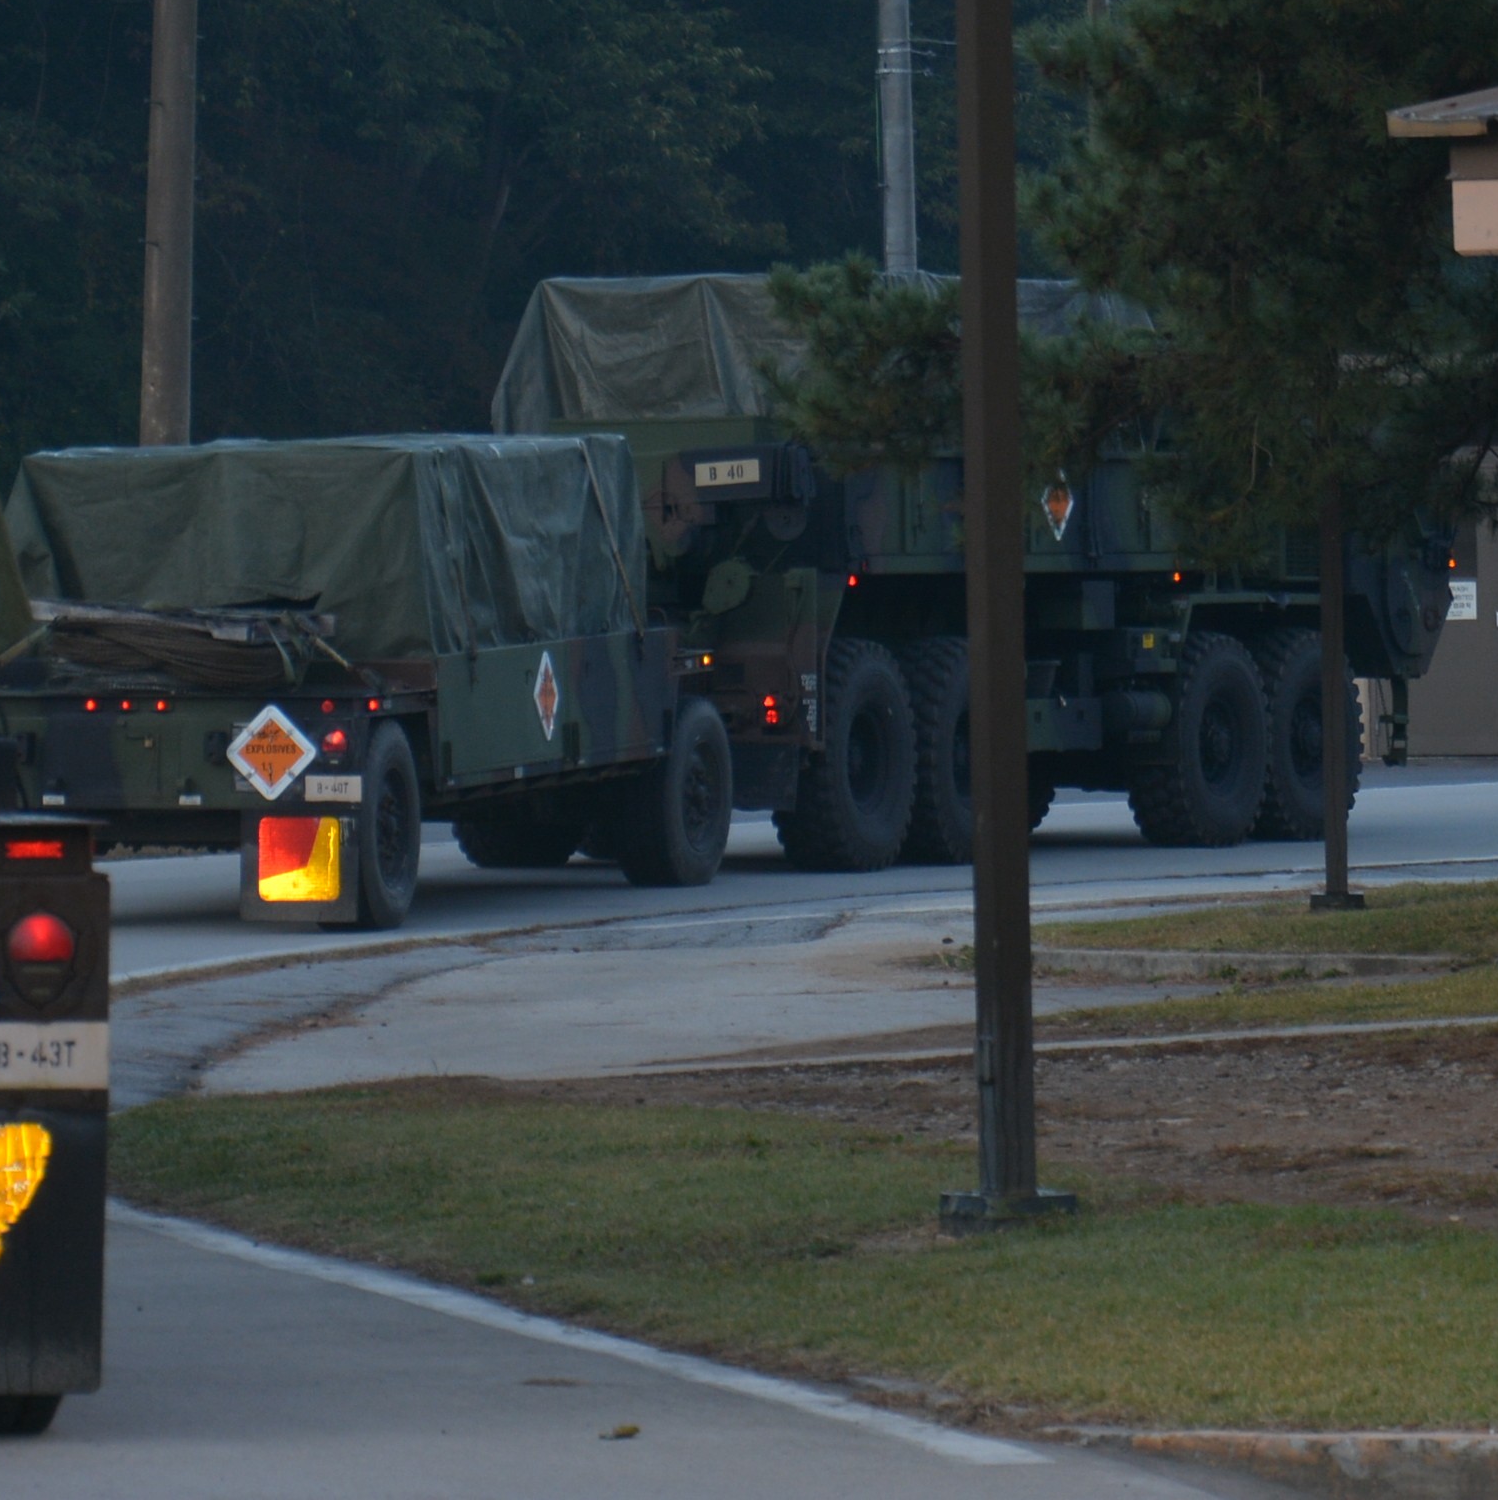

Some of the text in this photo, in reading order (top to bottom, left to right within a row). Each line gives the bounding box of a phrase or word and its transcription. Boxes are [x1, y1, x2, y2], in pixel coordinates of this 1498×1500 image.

[709, 464, 744, 481] B 40
[245, 744, 297, 755] EXPLOSIVES
